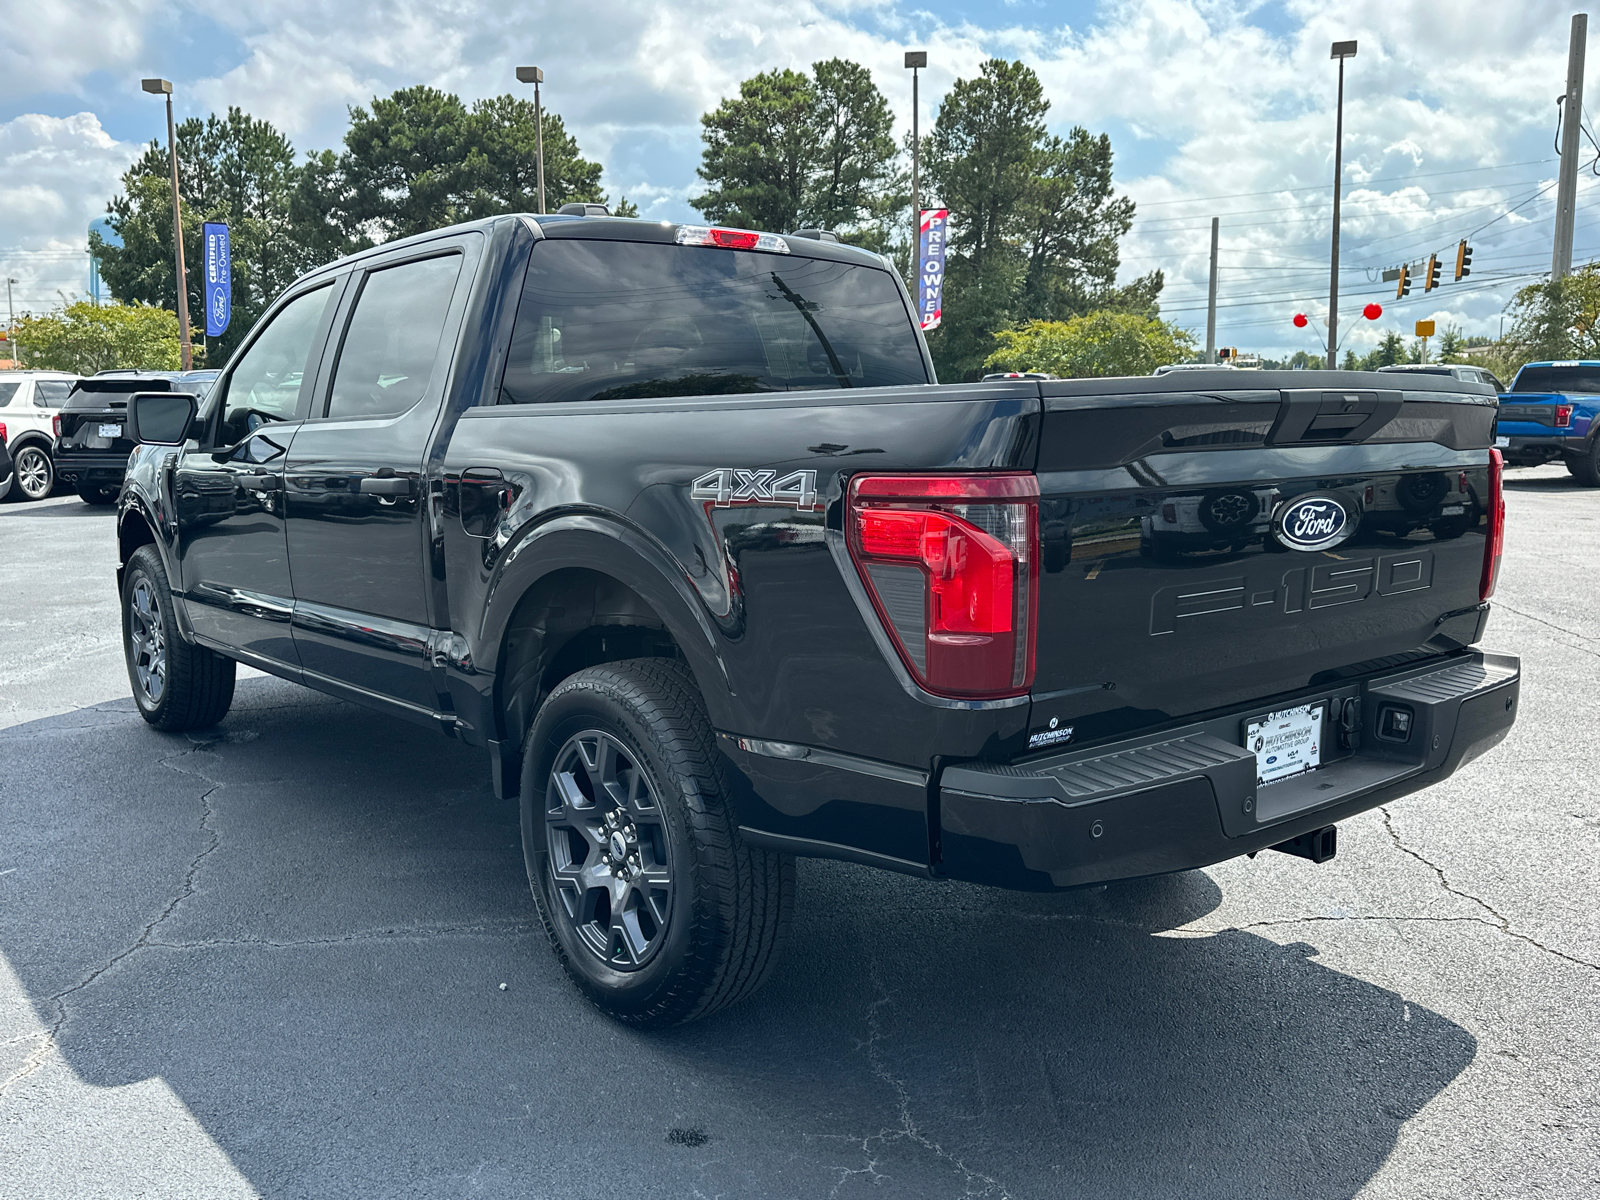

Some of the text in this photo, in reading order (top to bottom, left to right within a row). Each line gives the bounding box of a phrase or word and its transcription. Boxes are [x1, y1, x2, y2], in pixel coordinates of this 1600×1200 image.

[218, 234, 226, 284] Pre-Owned
[923, 218, 942, 324] PRE OWNED
[1294, 504, 1337, 537] Ford
[1150, 550, 1434, 636] F-150
[1275, 704, 1311, 720] HUTCHINSON
[1029, 727, 1073, 743] HUTCHINSON
[1265, 726, 1312, 748] HUTCHINSON
[1265, 737, 1309, 754] AUTOMOTIVE GROUP
